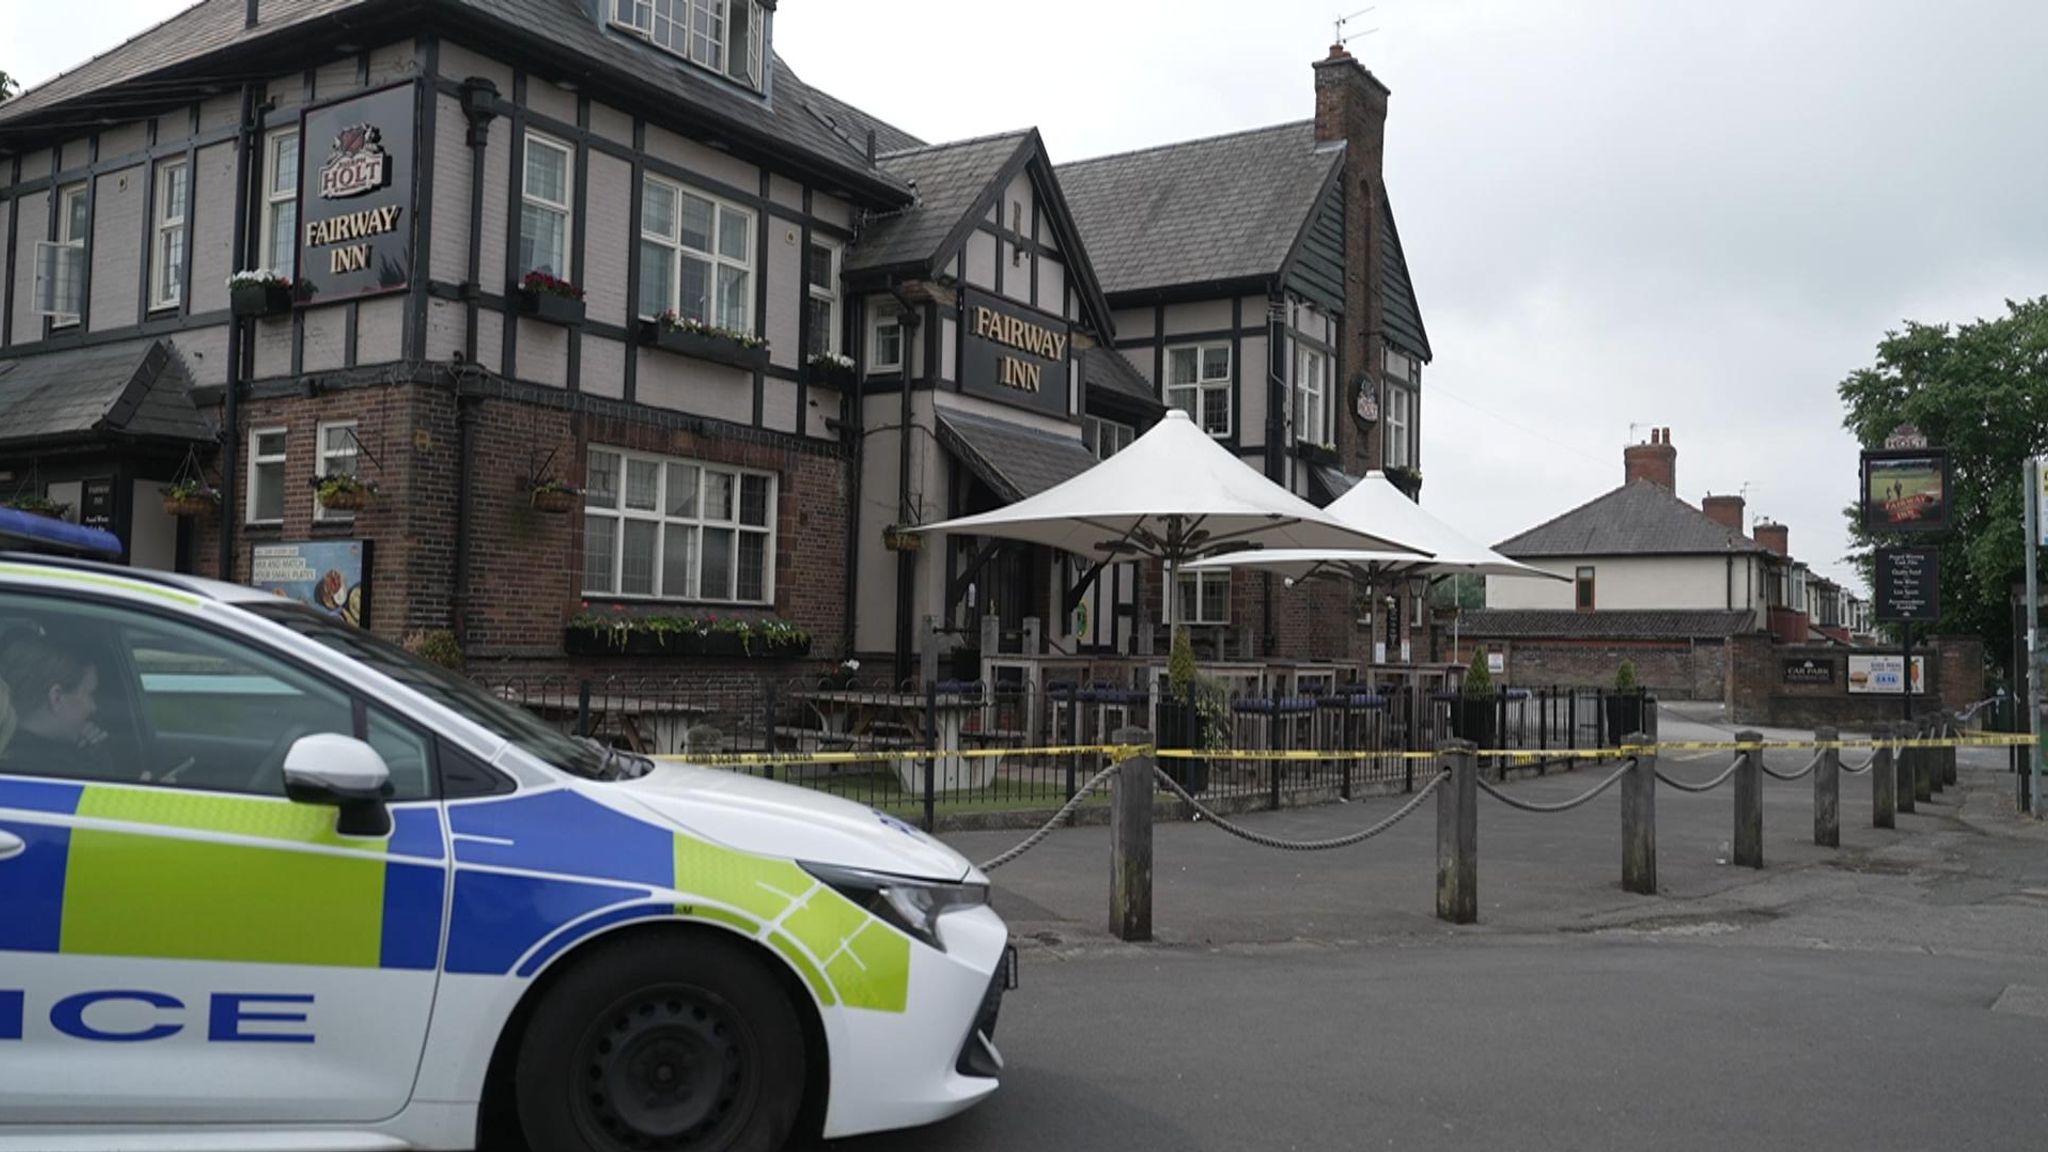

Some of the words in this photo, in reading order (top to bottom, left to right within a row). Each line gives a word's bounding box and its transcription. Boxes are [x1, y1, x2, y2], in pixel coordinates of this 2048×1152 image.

[323, 161, 380, 191] HOLT
[305, 204, 397, 247] FAIRWAY
[330, 243, 368, 274] INN
[977, 305, 1066, 361] FAIRWAY
[1004, 355, 1041, 393] INN
[1885, 494, 1926, 510] FAIRWAY
[1787, 667, 1805, 675] CAR
[1806, 667, 1829, 675] PARK
